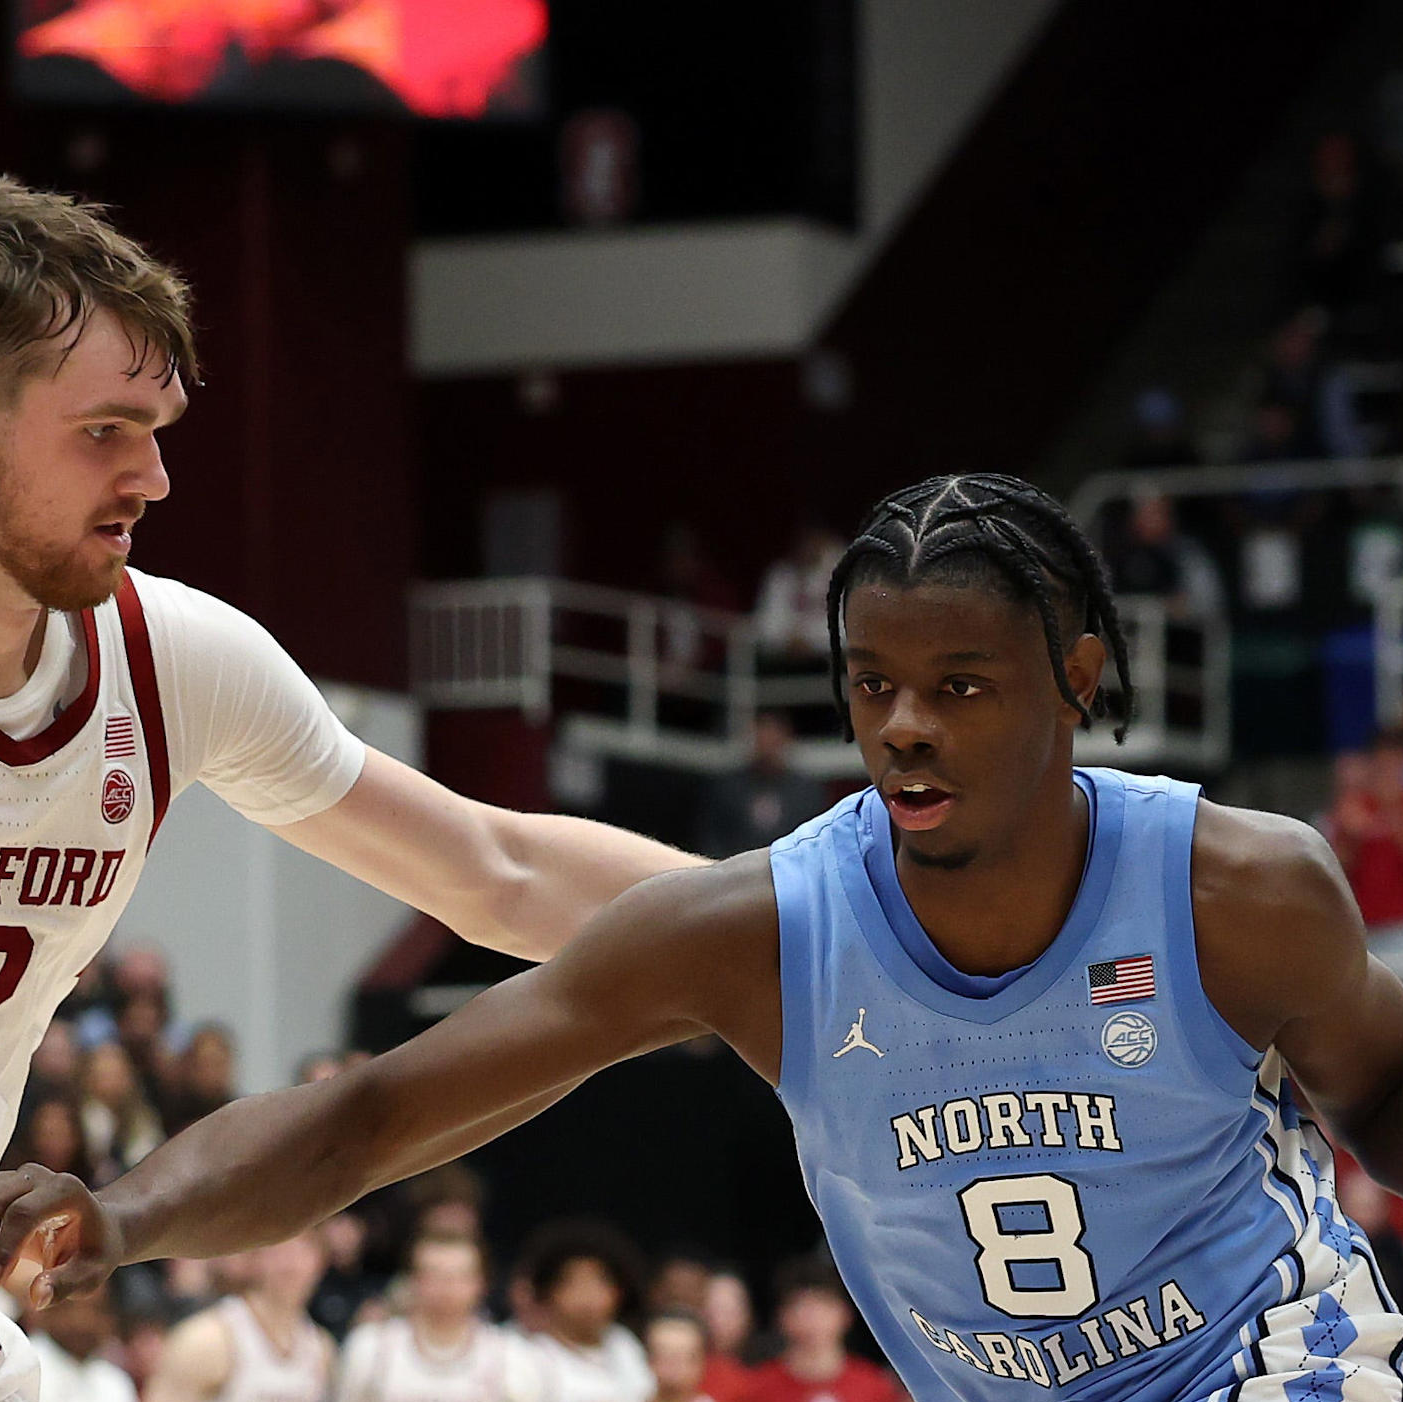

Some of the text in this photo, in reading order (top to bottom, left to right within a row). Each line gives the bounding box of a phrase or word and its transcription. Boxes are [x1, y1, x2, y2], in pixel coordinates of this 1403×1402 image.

[890, 1091, 1124, 1171] NORTH
[956, 1172, 1100, 1320] 8
[909, 1278, 1207, 1388] CAROLINA
